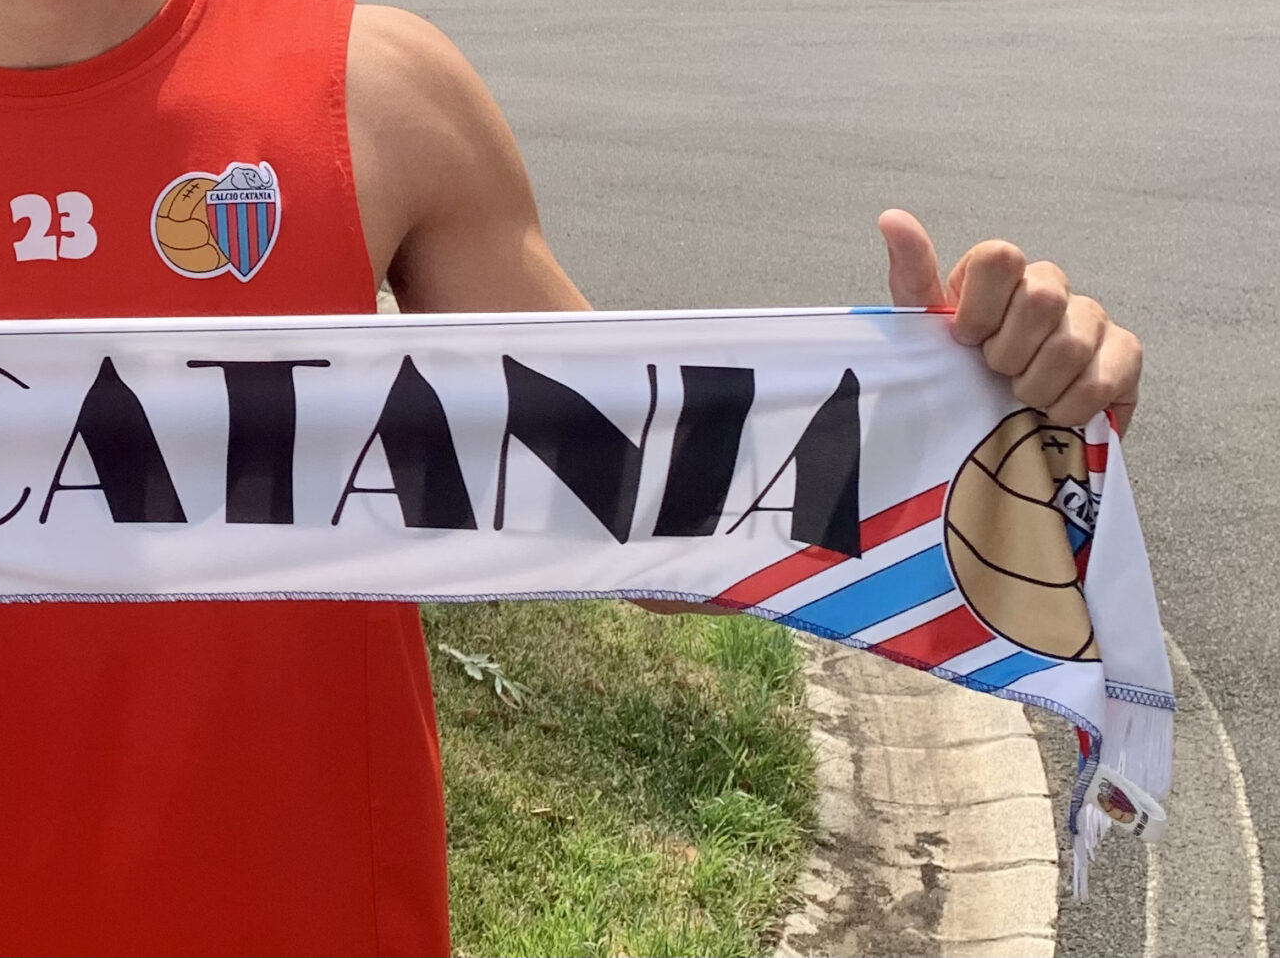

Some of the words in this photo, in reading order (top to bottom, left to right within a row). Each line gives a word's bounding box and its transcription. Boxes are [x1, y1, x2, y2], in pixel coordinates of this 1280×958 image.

[209, 192, 239, 202] CALCIO
[239, 191, 273, 201] CATANIA
[9, 190, 98, 262] 23
